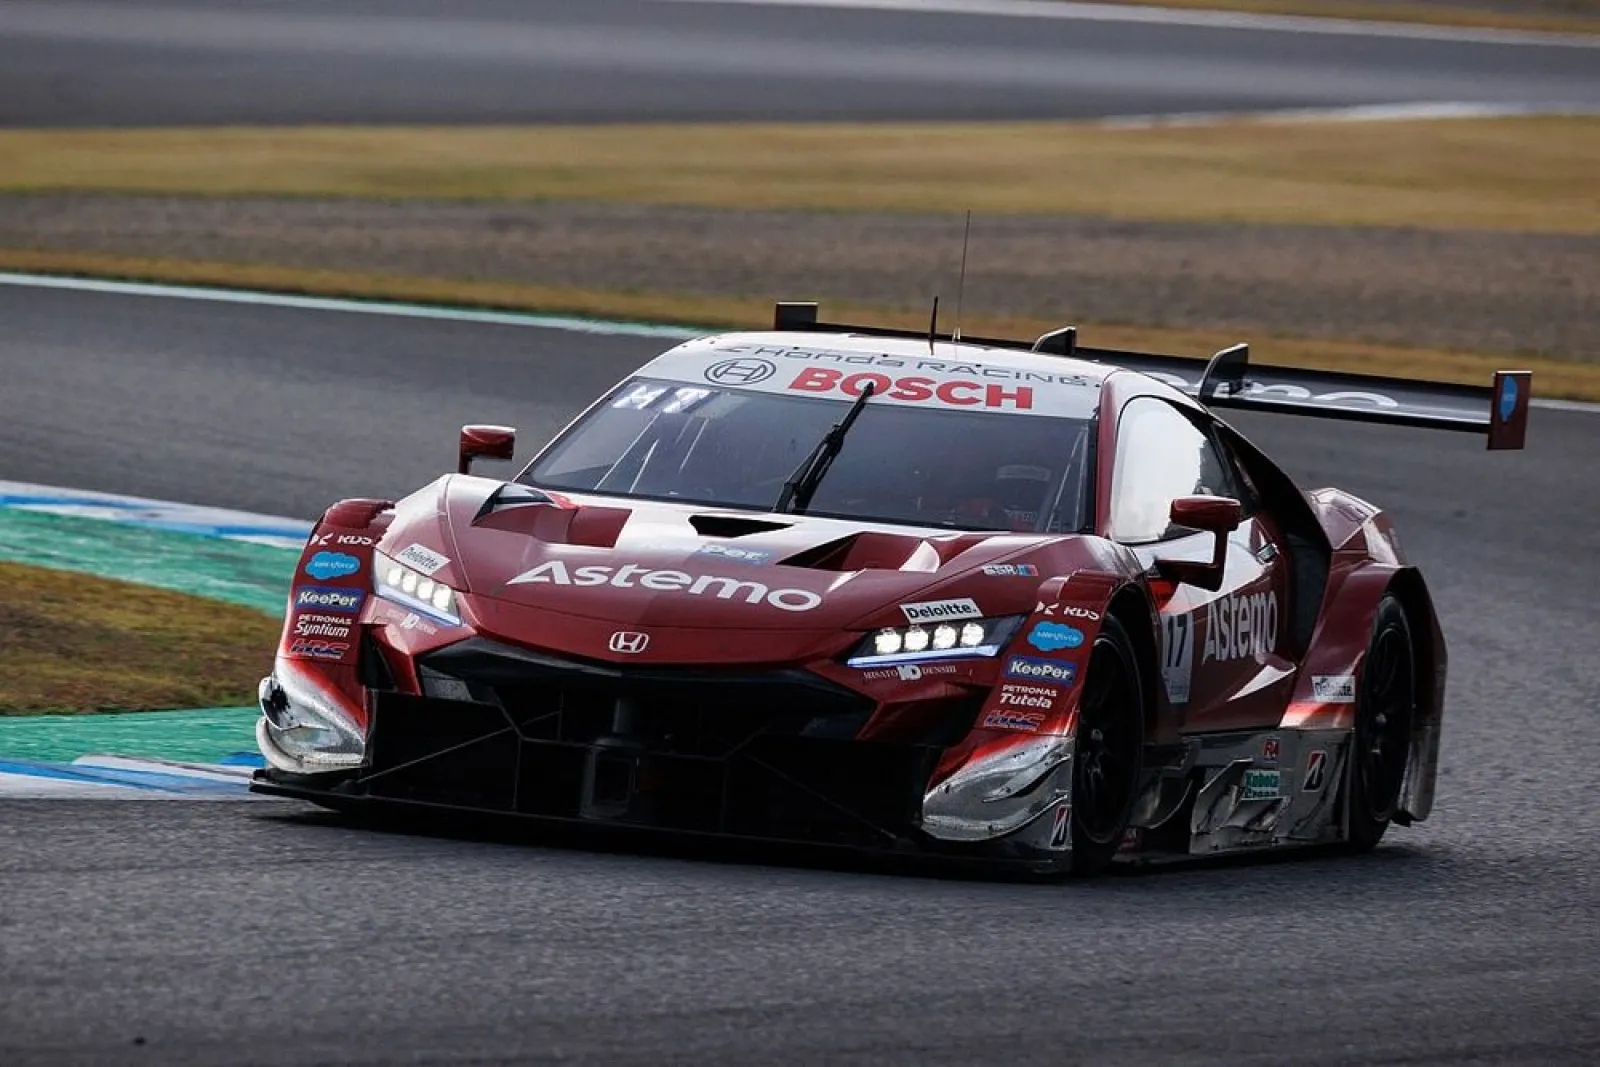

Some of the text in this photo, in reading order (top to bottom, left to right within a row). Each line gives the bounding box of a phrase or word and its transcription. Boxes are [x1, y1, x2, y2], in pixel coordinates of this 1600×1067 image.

[755, 347, 1087, 387] Honda RACING
[788, 366, 1033, 410] BOSCH
[506, 560, 822, 612] Astemo
[299, 591, 357, 607] KeePer
[299, 614, 353, 625] PETRONAS
[1201, 589, 1278, 667] Astemo
[294, 621, 349, 637] Syntium
[1167, 614, 1188, 668] 17
[1010, 661, 1071, 679] KeePer
[1002, 684, 1057, 697] PETRONAS
[1000, 693, 1052, 709] Tutela
